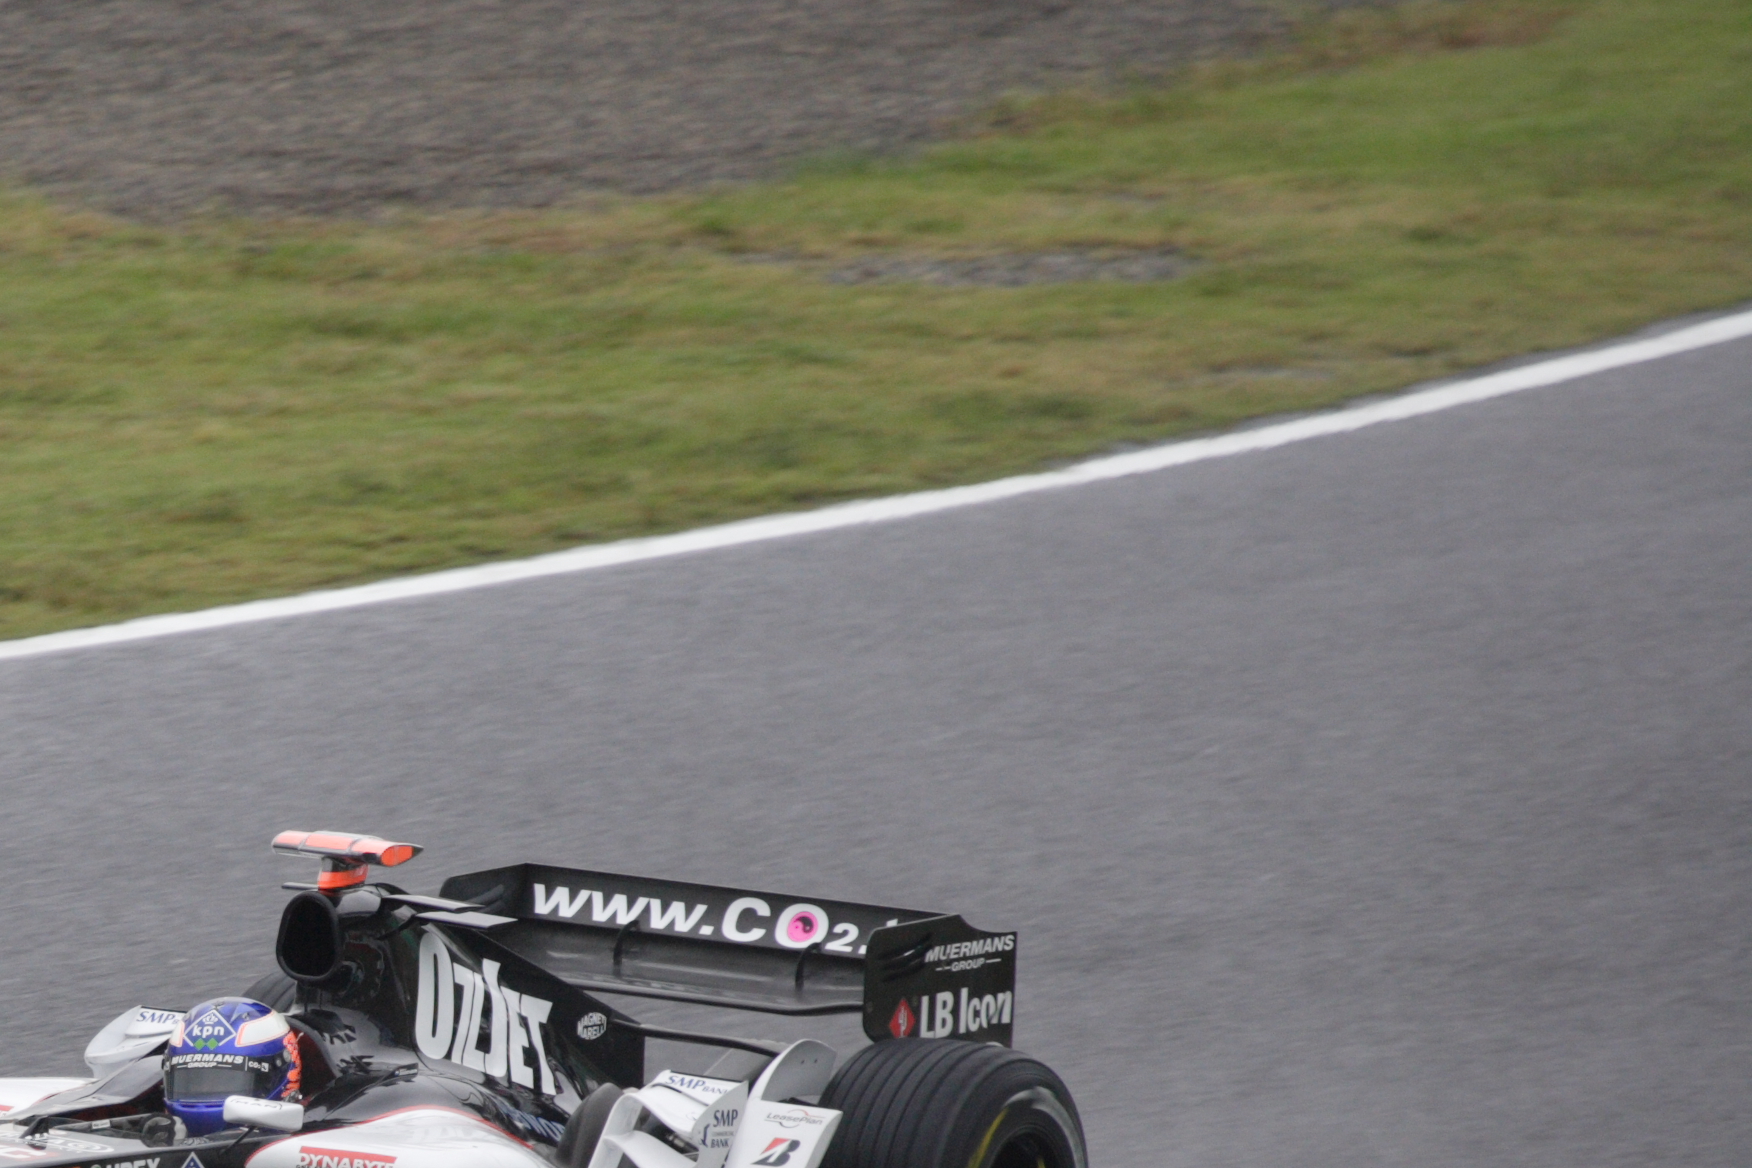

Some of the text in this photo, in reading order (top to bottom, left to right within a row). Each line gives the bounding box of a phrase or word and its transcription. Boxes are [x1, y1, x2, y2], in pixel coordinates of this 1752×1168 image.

[533, 882, 898, 955] www.CO2.
[924, 935, 1015, 962] MUERMANS
[951, 957, 986, 971] GROUP
[136, 1010, 176, 1024] SMP
[919, 991, 955, 1039] LB
[959, 987, 1013, 1034] Icon
[192, 1023, 224, 1038] kpn
[171, 1053, 244, 1065] MUERMANS
[187, 1061, 217, 1069] GROUP
[665, 1075, 706, 1090] SMP
[712, 1108, 739, 1128] SMP
[766, 1112, 824, 1126] LeasePlan
[710, 1138, 730, 1149] BANK
